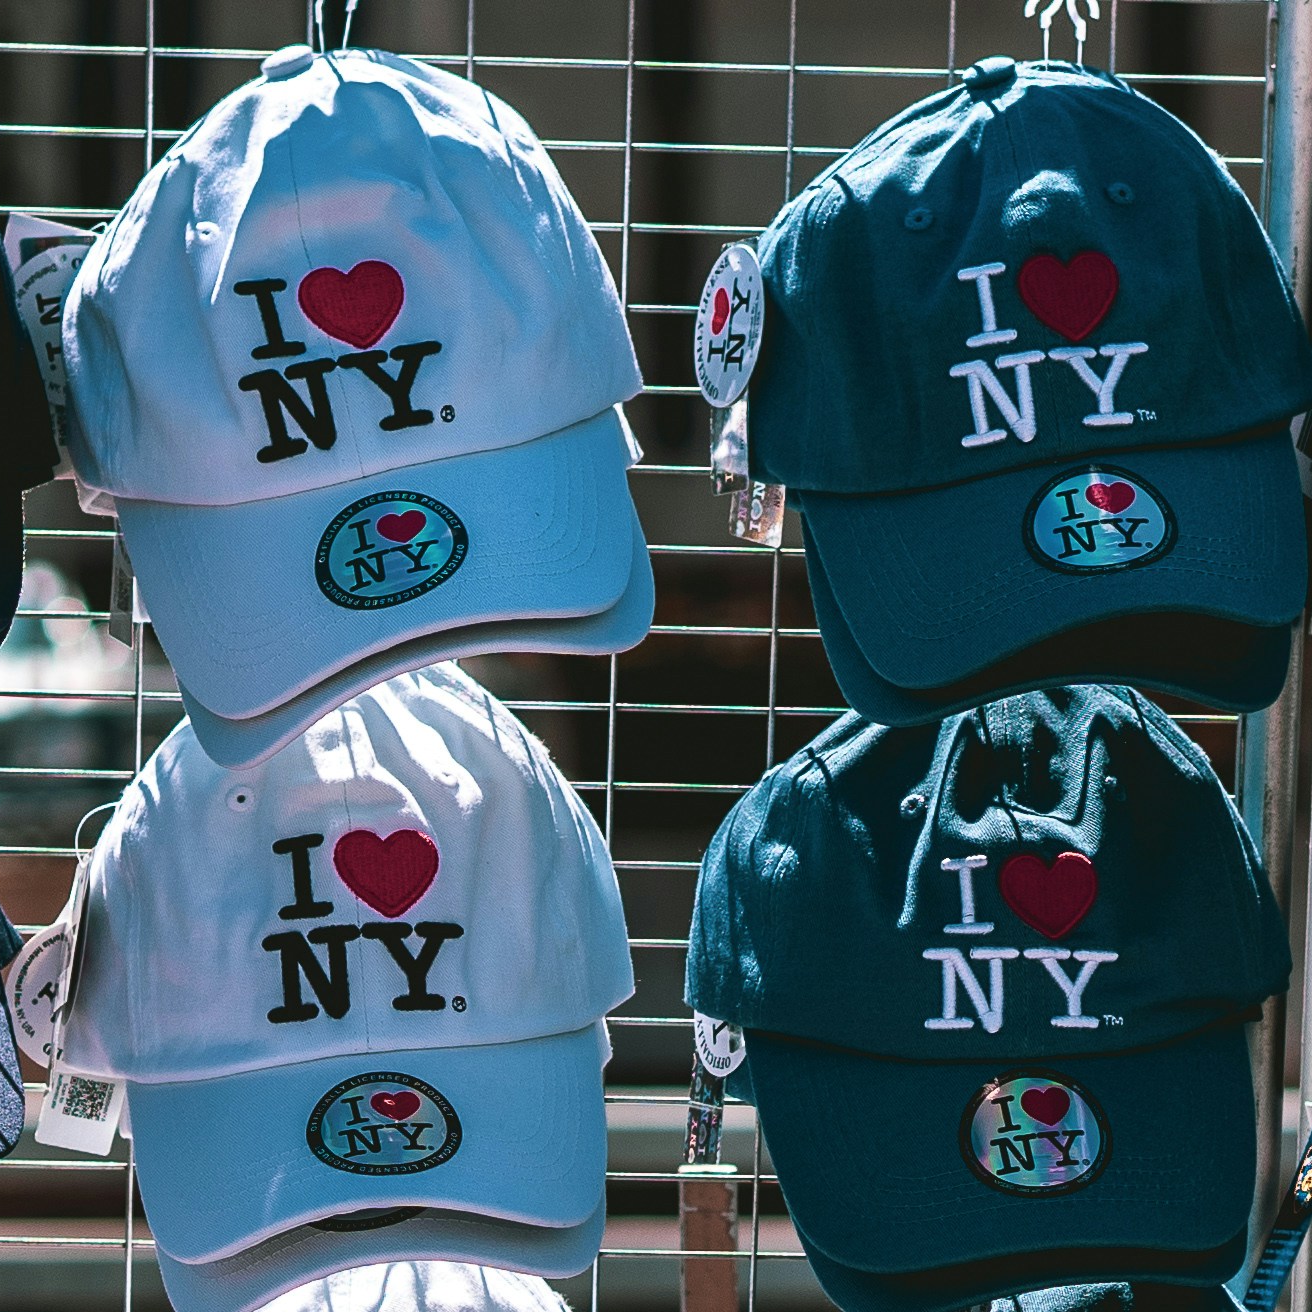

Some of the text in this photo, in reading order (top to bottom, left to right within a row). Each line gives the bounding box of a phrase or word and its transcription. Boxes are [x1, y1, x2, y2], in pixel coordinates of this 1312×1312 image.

[233, 278, 307, 360] I
[958, 262, 1017, 347] I
[358, 492, 417, 508] LICENSED
[421, 497, 462, 529] PRODUCT
[1055, 488, 1085, 522] I
[348, 518, 376, 555] I
[272, 833, 334, 920] I
[940, 855, 994, 934] I
[340, 1095, 370, 1126] I
[991, 1095, 1022, 1134] I
